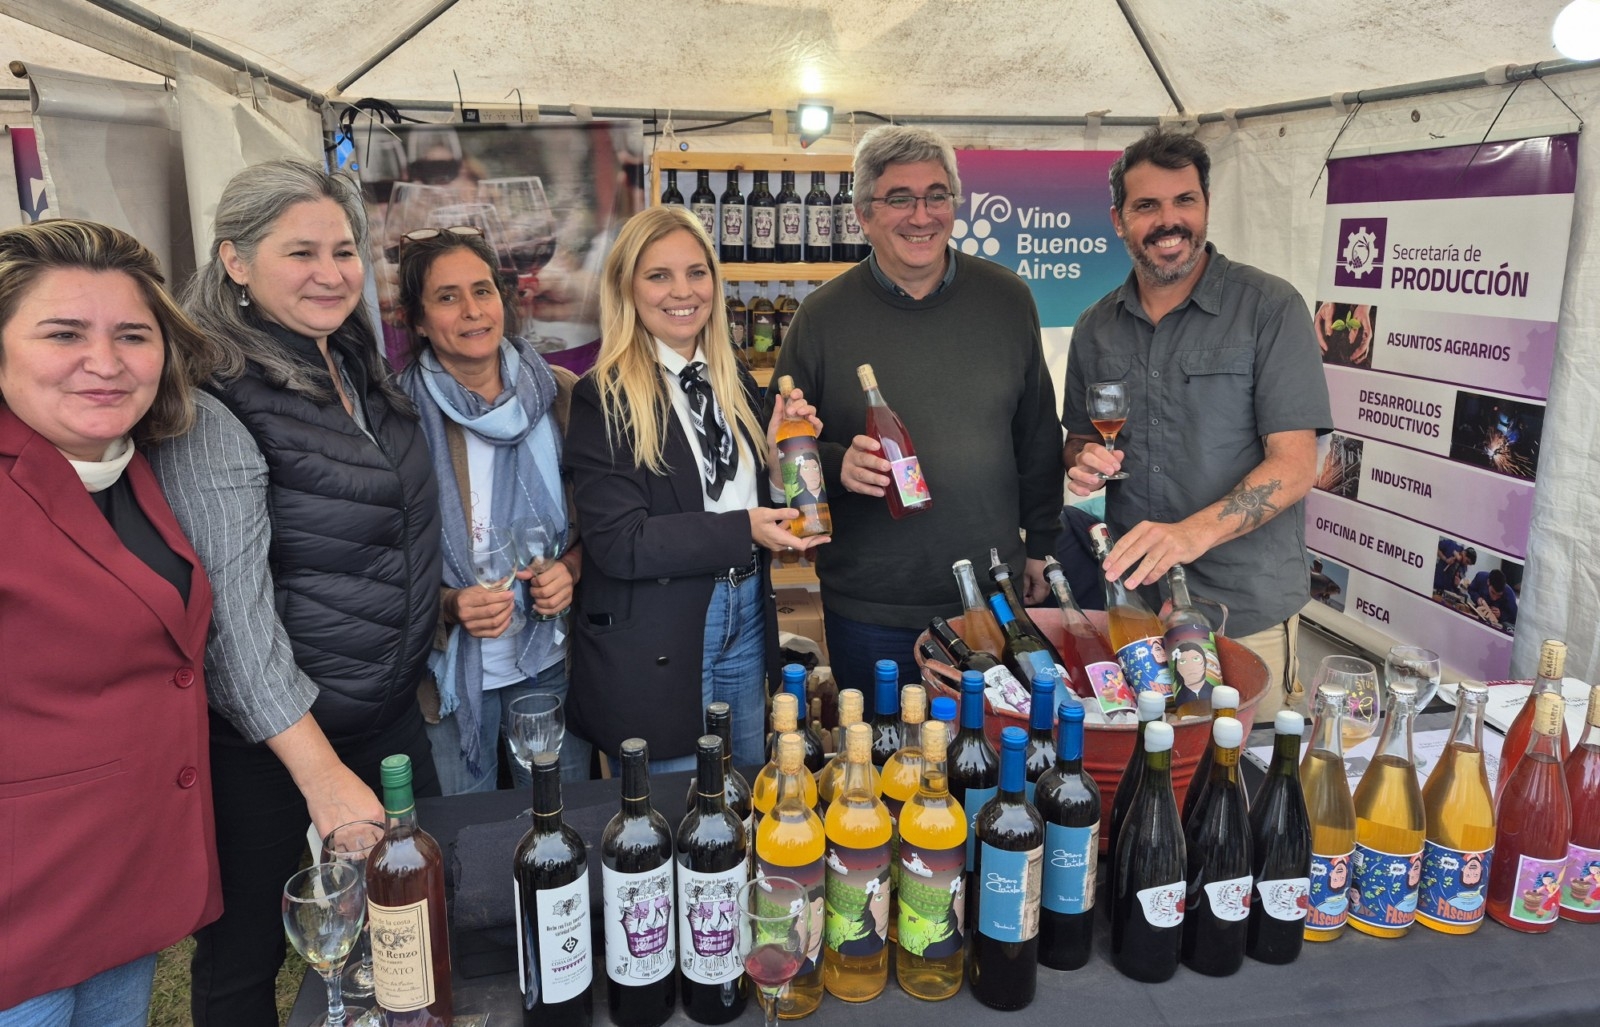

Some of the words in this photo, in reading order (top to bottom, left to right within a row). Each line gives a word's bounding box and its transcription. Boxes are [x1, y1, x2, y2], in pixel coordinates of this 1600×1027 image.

[1016, 206, 1071, 229] Vino
[1016, 233, 1108, 255] Buenos
[1392, 243, 1459, 263] Secretaría
[1463, 245, 1482, 263] de
[1016, 258, 1081, 280] Aires
[1390, 262, 1530, 298] PRODUCCIÓN
[1386, 332, 1442, 353] ASUNTOS
[1443, 337, 1511, 362] AGRARIOS
[1358, 389, 1442, 419] DESARROLLOS
[1357, 407, 1441, 438] PRODUCTIVOS
[1370, 467, 1433, 499] INDUSTRIA
[1315, 516, 1356, 545] OFICINA
[1356, 531, 1374, 551] DE
[1376, 540, 1424, 569] EMPLEO
[1355, 597, 1391, 624] PESCA
[386, 948, 418, 960] Renzo
